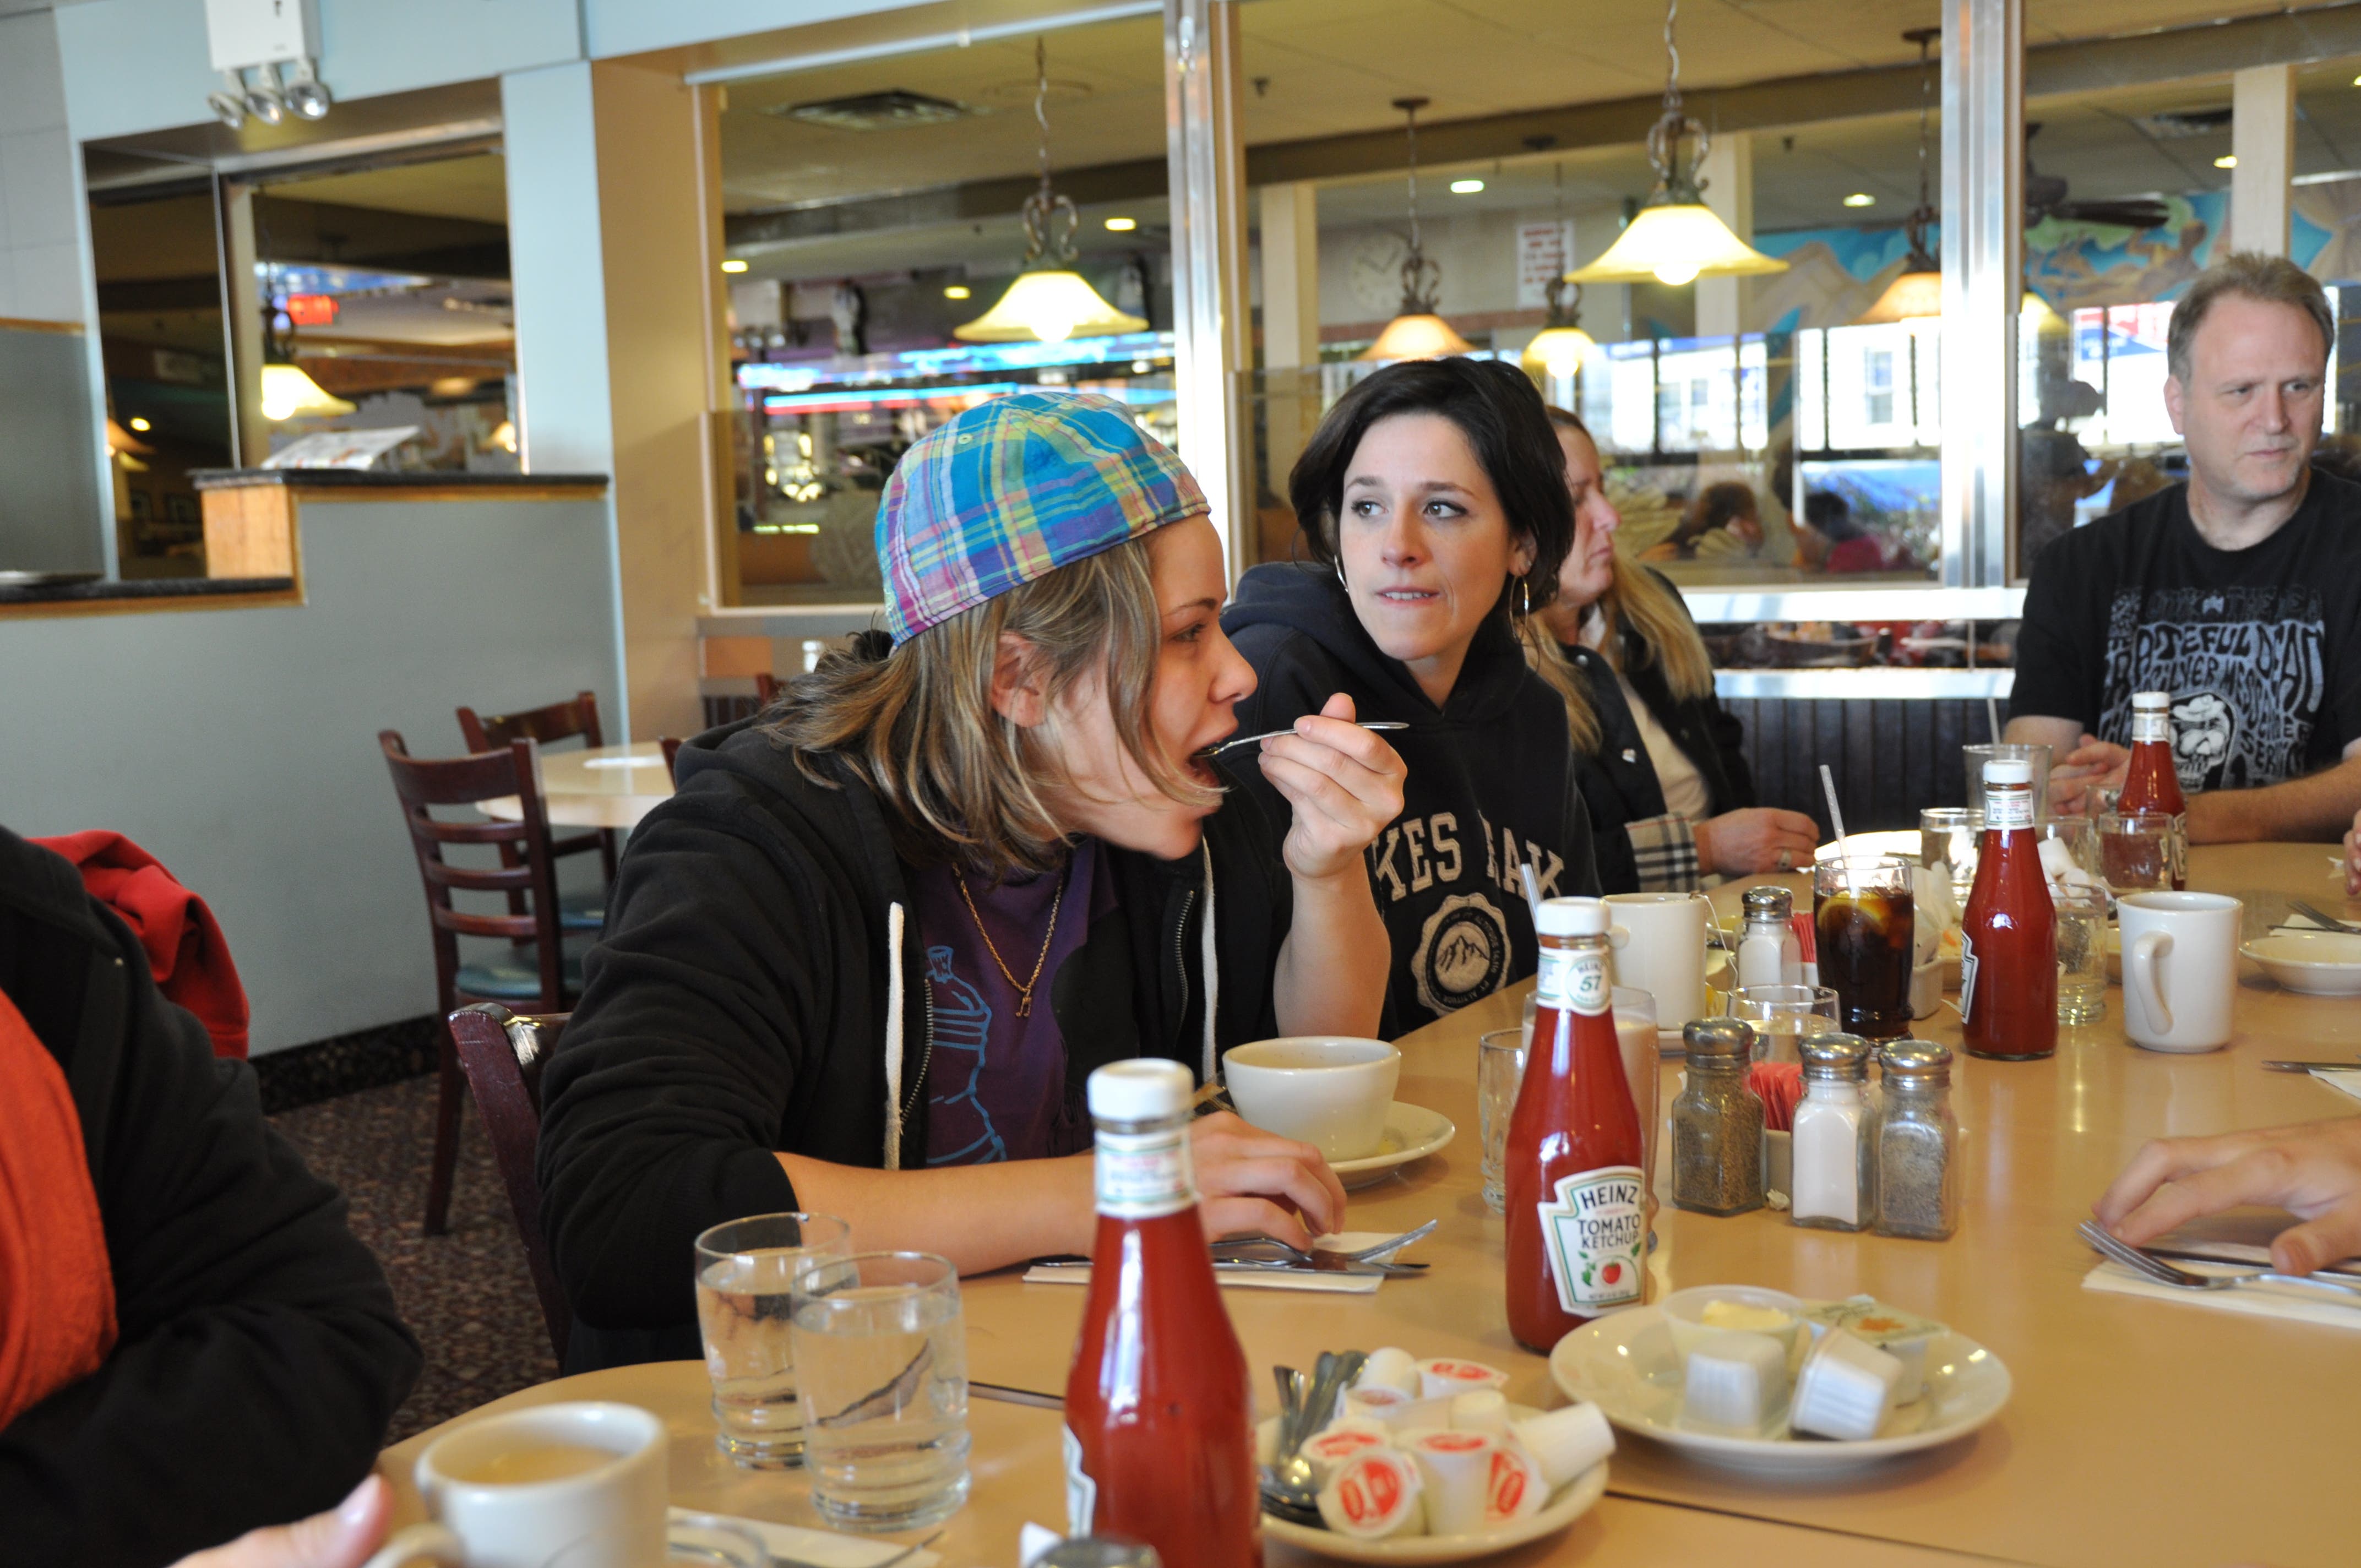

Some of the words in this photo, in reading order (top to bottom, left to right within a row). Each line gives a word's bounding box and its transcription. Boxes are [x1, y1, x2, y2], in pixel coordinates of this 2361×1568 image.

[1373, 812, 1462, 903] KES
[1580, 975, 1602, 991] 57
[1580, 1185, 1638, 1209] HEINZ
[1576, 1213, 1641, 1236] TOMATO
[1581, 1232, 1639, 1249] KETCHUP
